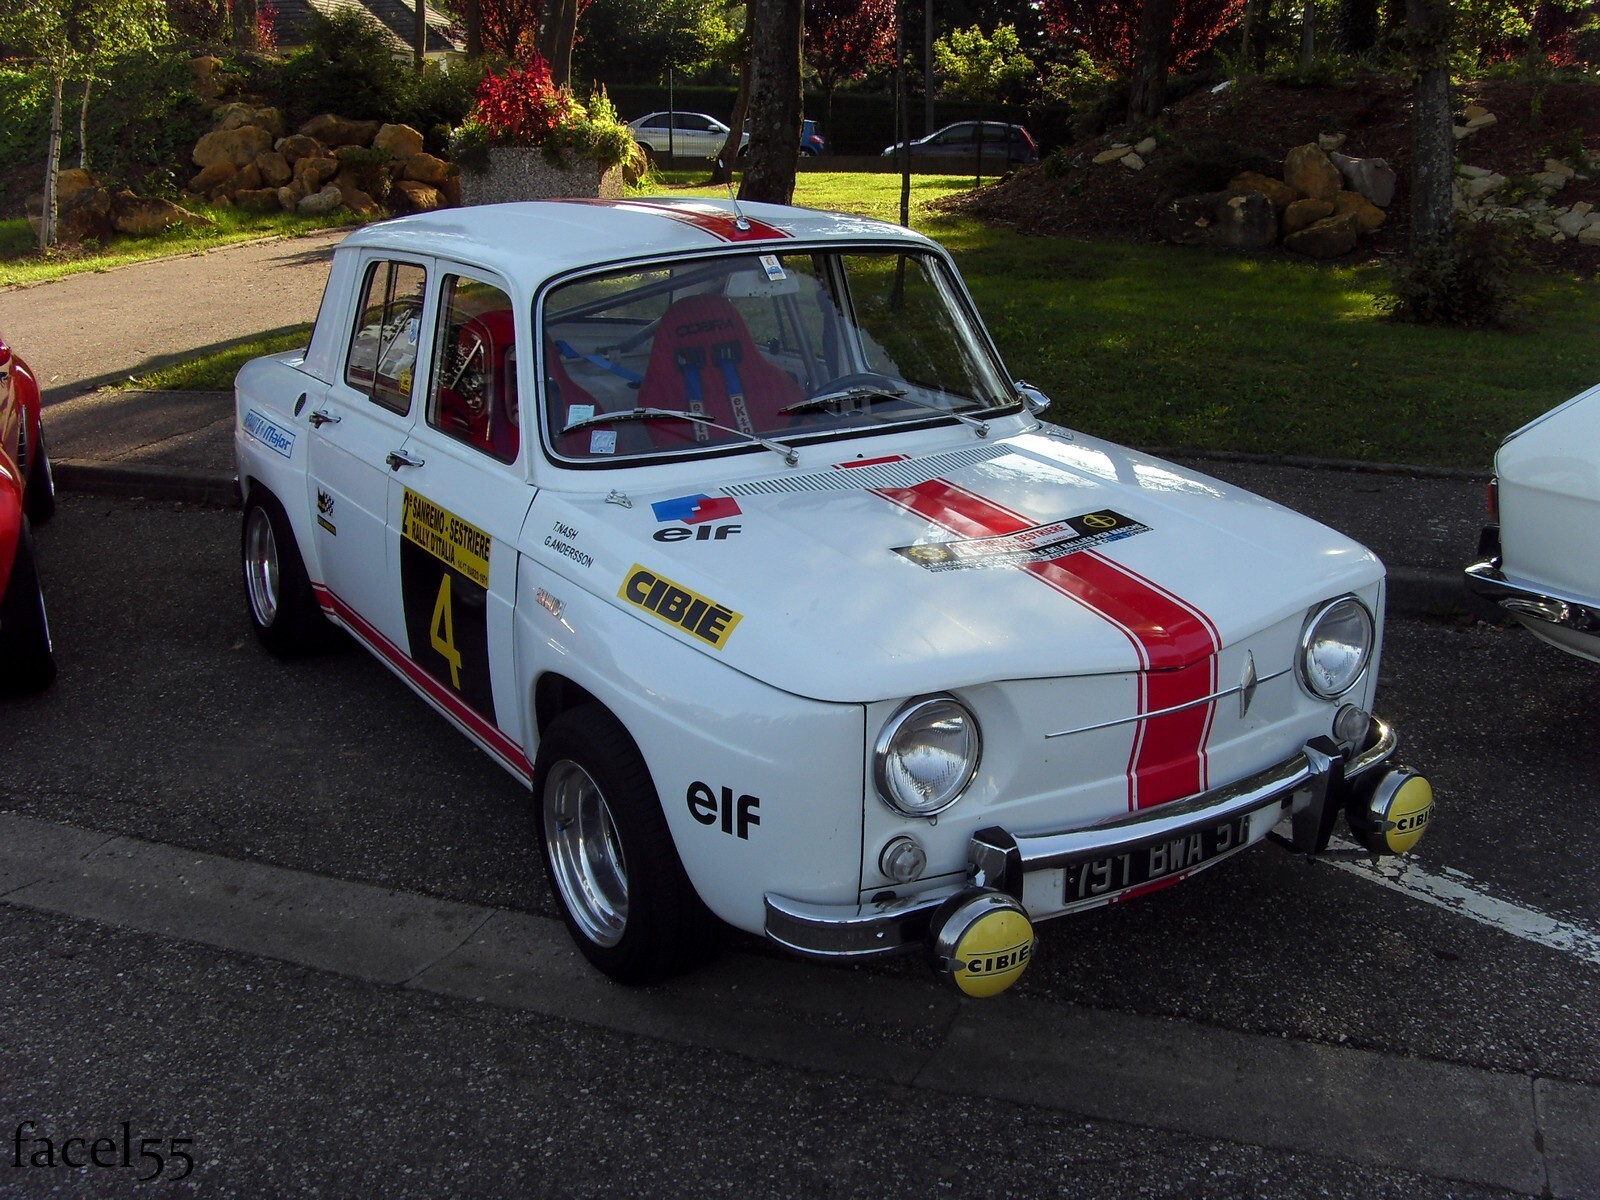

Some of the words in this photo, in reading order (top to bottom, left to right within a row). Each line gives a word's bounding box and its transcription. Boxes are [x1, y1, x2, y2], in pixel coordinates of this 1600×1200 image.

[675, 320, 734, 337] COBRA
[263, 425, 292, 450] Major
[412, 496, 445, 535] SANREMO
[449, 517, 491, 562] SESTRIERE
[412, 520, 430, 549] RALLY
[430, 532, 455, 566] D'ITALIA
[552, 520, 579, 541] T.NASH
[652, 524, 742, 543] elf
[1014, 524, 1068, 543] SESTRIERE
[544, 536, 594, 569] G.ANDERSSON
[430, 572, 462, 690] 4
[686, 780, 761, 840] elf
[1149, 832, 1203, 878] BWA
